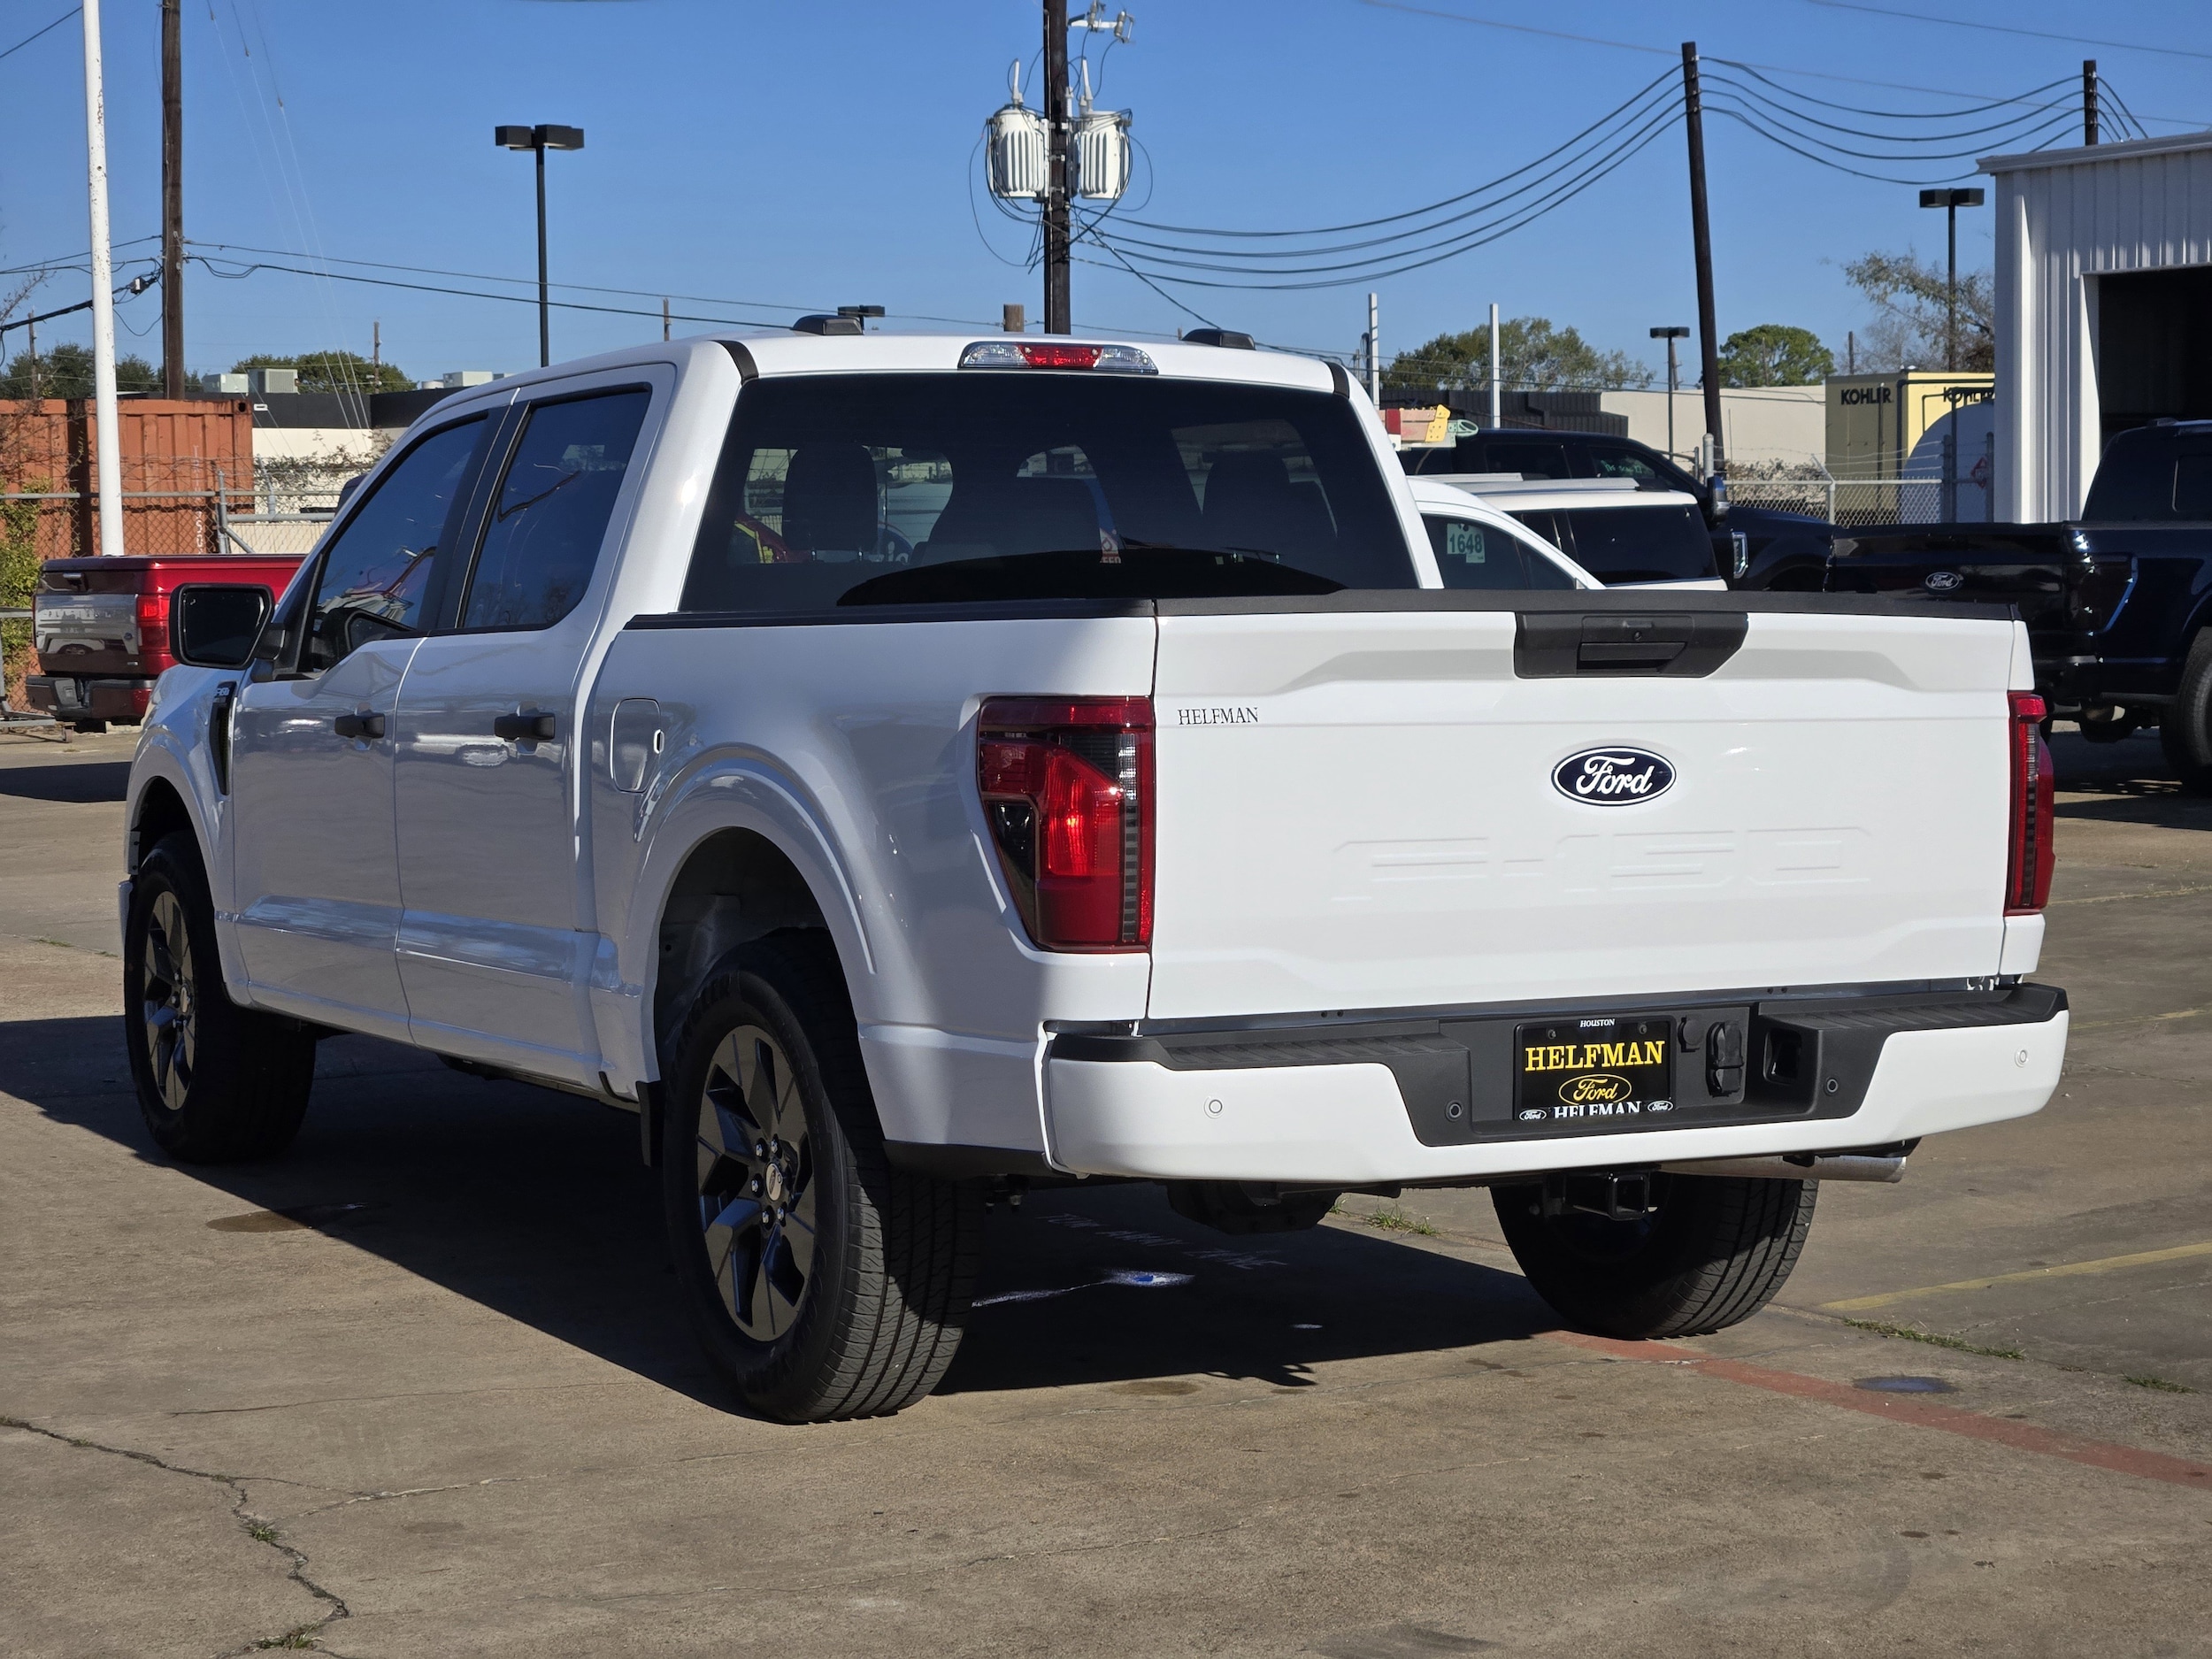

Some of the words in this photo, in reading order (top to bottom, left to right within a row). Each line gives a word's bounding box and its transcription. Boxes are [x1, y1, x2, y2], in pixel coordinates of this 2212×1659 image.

[1449, 533, 1483, 554] 1648
[1931, 574, 1954, 588] Ford
[1178, 707, 1258, 725] HELFMAN
[1576, 756, 1655, 795] Ford
[1579, 1018, 1616, 1028] HOUSTON
[1525, 1041, 1665, 1071] HELFMAN
[1572, 1079, 1619, 1101] Ford
